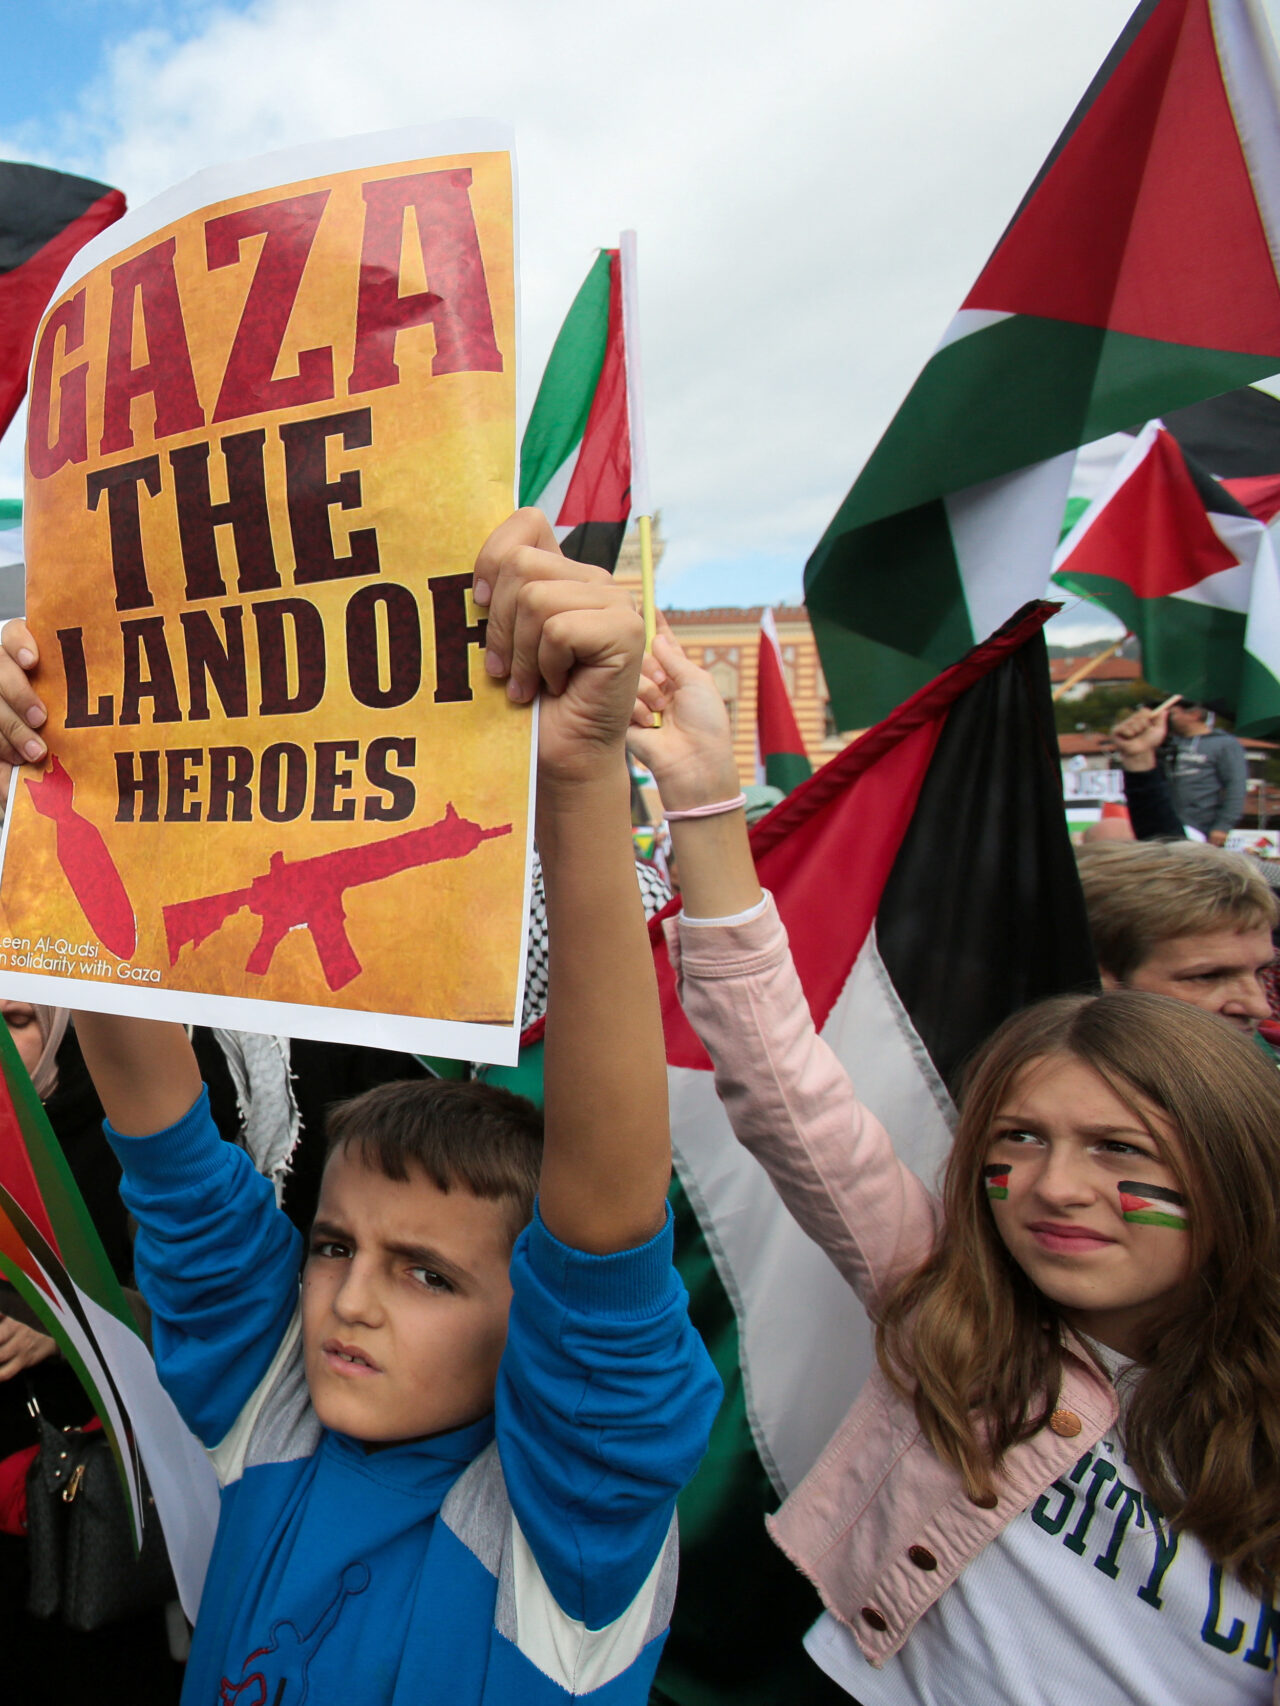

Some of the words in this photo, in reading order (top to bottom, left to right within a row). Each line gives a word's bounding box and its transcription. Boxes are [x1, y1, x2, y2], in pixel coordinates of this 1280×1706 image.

[27, 167, 504, 480] GAZA
[86, 406, 381, 613] THE
[56, 597, 326, 728] LAND
[345, 582, 488, 709] OF
[114, 736, 417, 823] HEROES
[11, 951, 76, 976] solidarity
[79, 959, 112, 977] with
[116, 962, 162, 983] Gaza
[34, 936, 100, 958] Al-Qudsi
